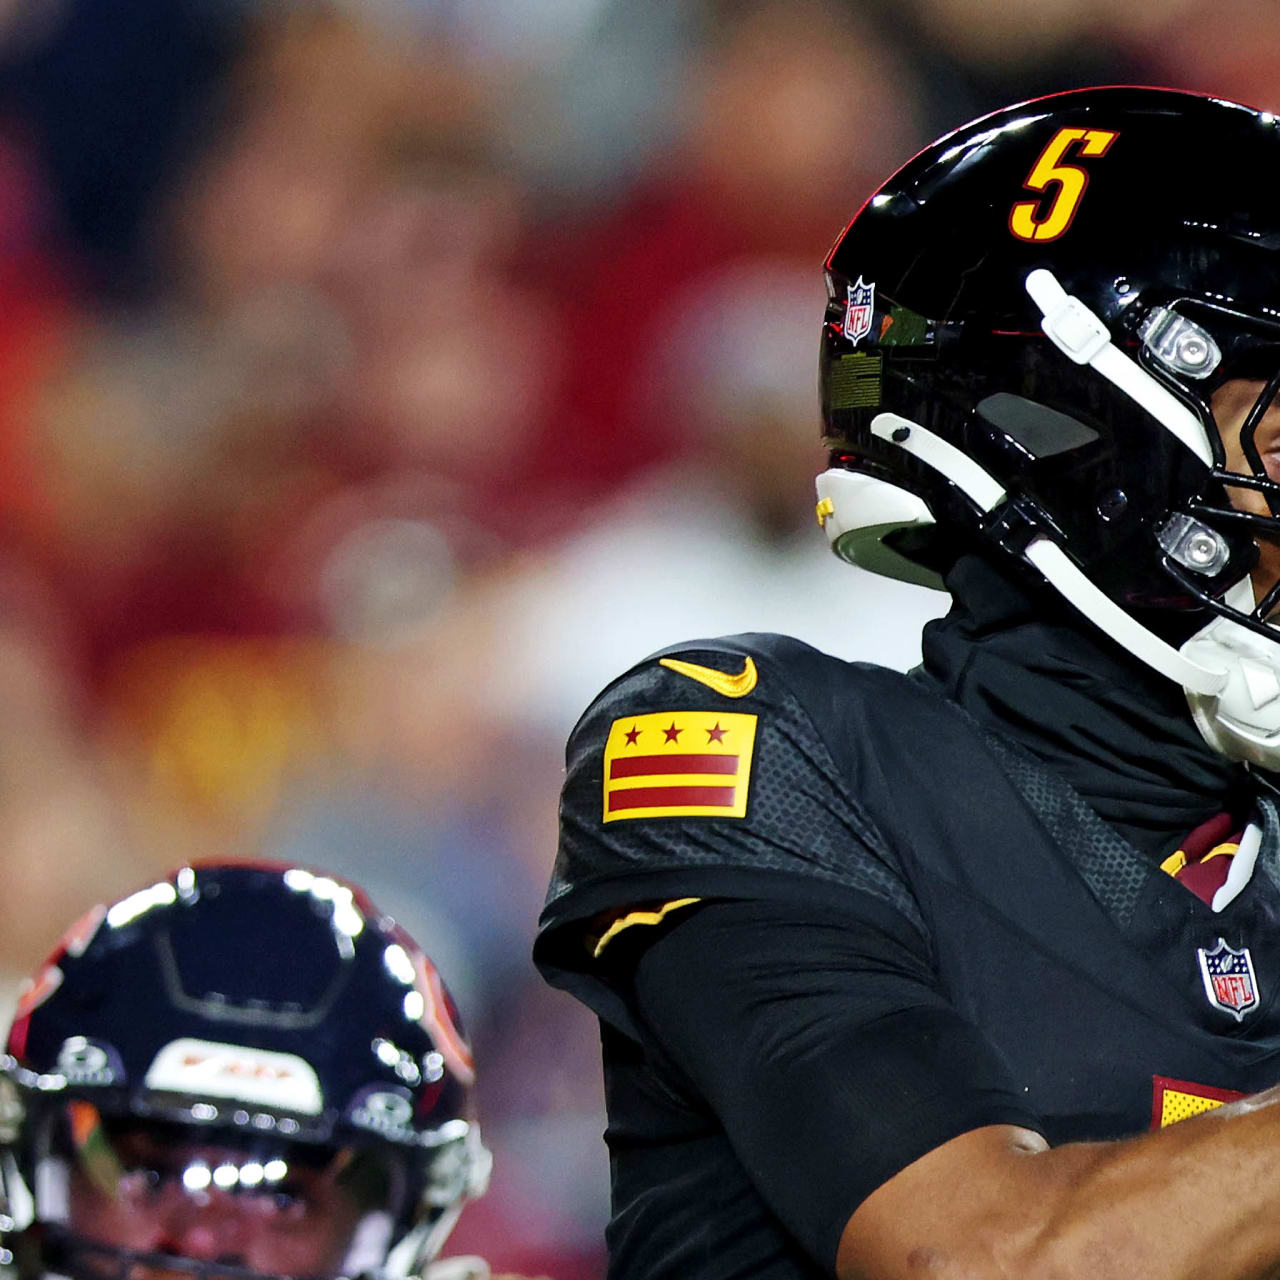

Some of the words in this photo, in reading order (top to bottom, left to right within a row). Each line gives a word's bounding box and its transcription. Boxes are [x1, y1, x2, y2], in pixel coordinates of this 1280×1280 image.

[1008, 126, 1120, 243] 5
[848, 307, 868, 333] NFL
[1214, 976, 1253, 1006] NFL
